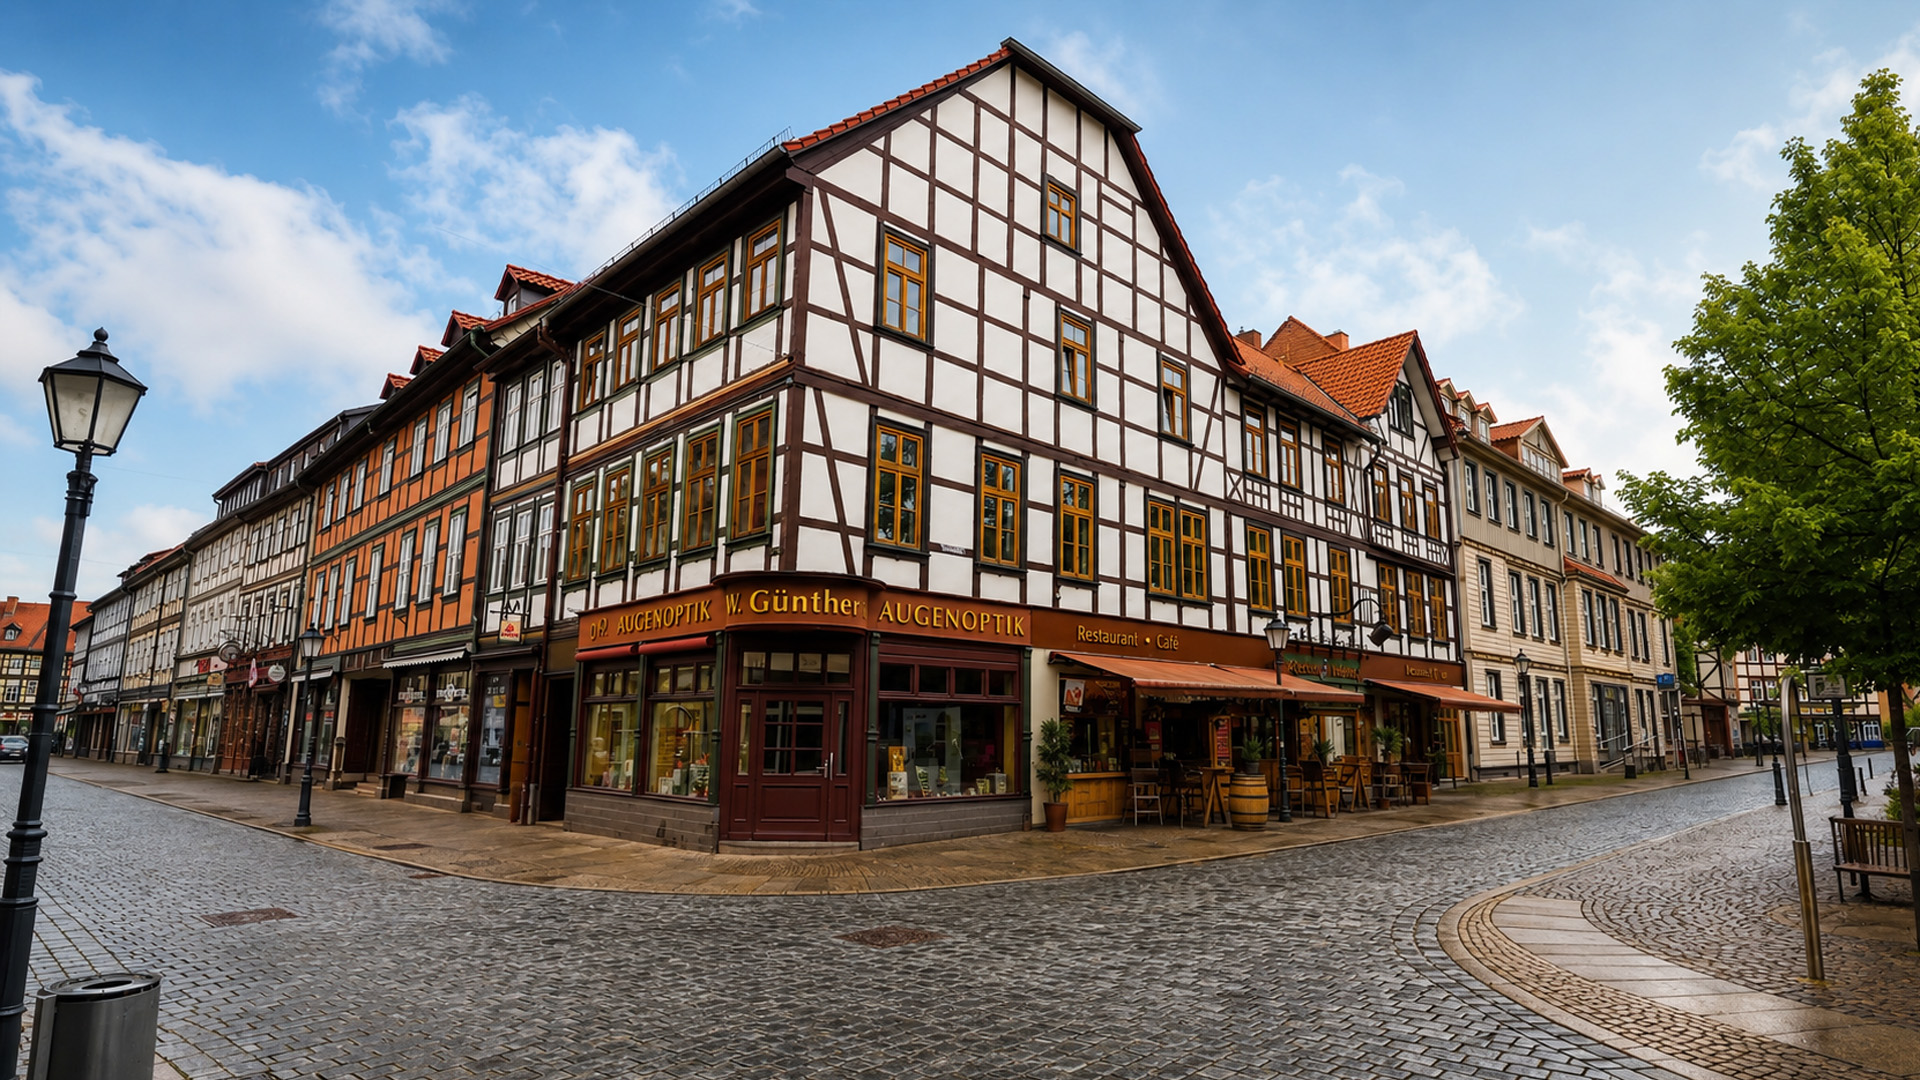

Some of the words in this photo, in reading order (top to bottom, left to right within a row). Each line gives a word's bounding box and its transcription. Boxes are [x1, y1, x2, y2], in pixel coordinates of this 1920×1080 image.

[616, 599, 711, 635] AUGENOPTIK
[726, 593, 742, 615] W.
[750, 589, 860, 615] Günther
[878, 600, 1024, 636] AUGENOPTIK
[1077, 625, 1138, 647] Restaurant
[1156, 634, 1179, 650] Café
